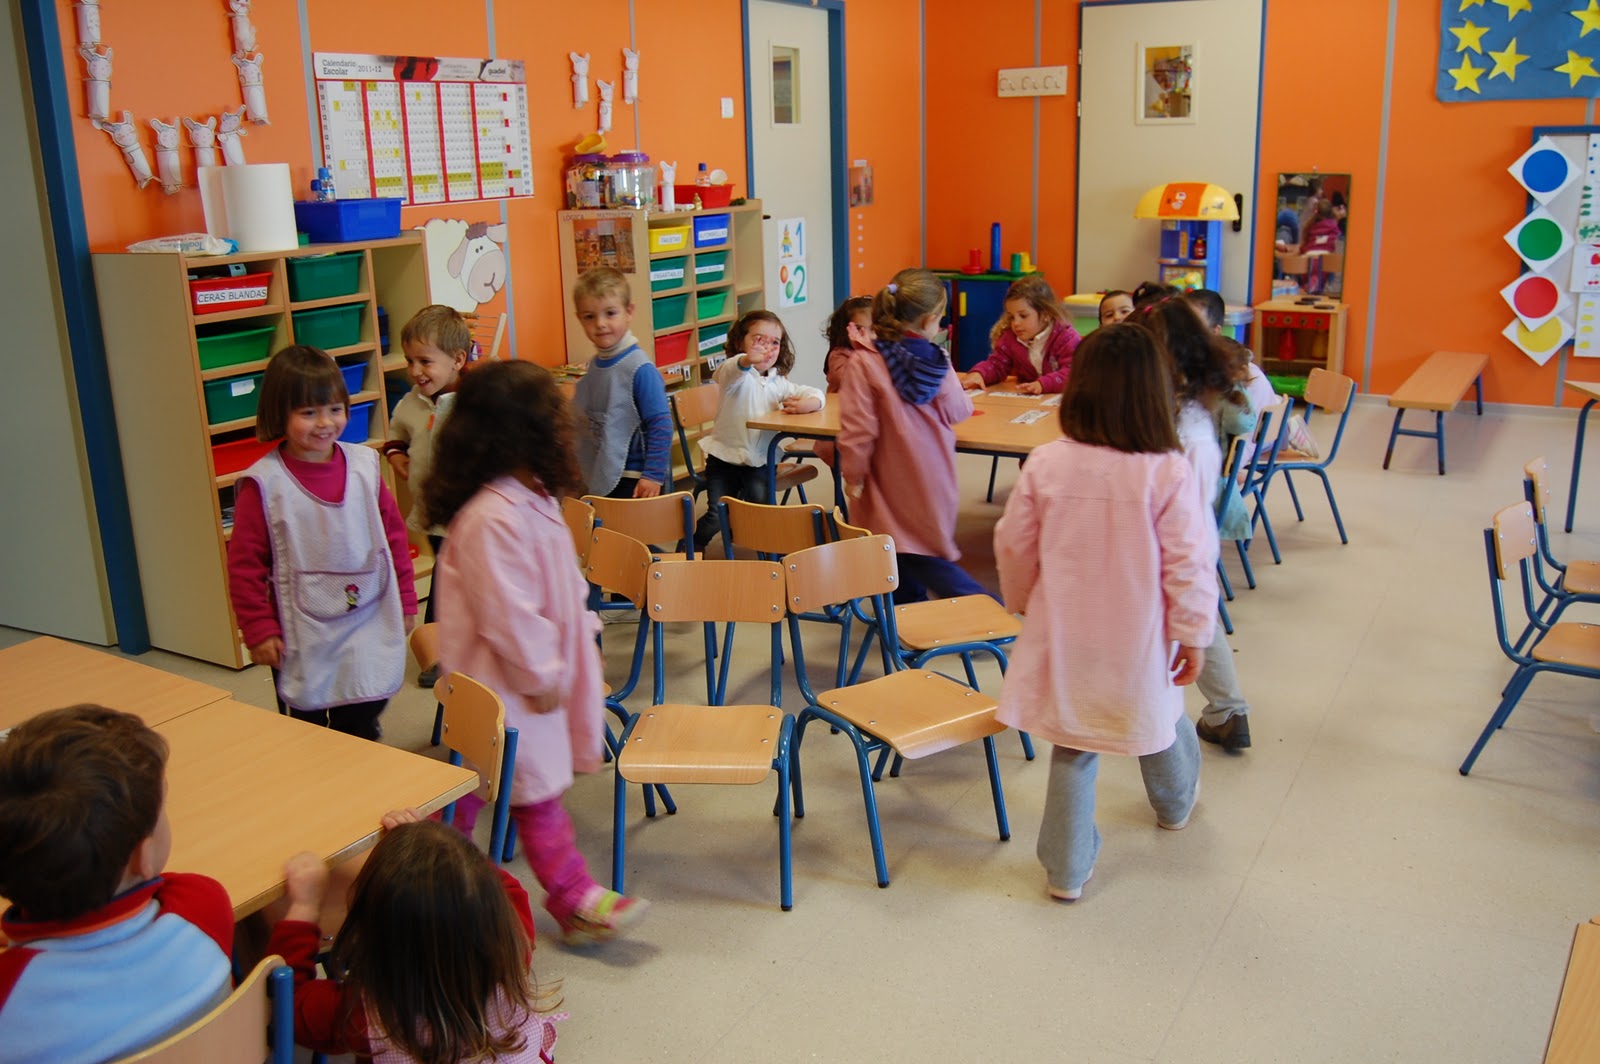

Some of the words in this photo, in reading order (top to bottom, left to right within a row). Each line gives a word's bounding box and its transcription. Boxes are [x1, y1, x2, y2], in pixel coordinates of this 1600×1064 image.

[322, 59, 357, 67] Calendario
[323, 67, 349, 76] Escolar
[358, 65, 383, 73] 2011-12
[795, 222, 803, 256] 1
[793, 265, 806, 304] 2
[197, 292, 226, 303] CERAS
[228, 289, 267, 300] BLANDAS
